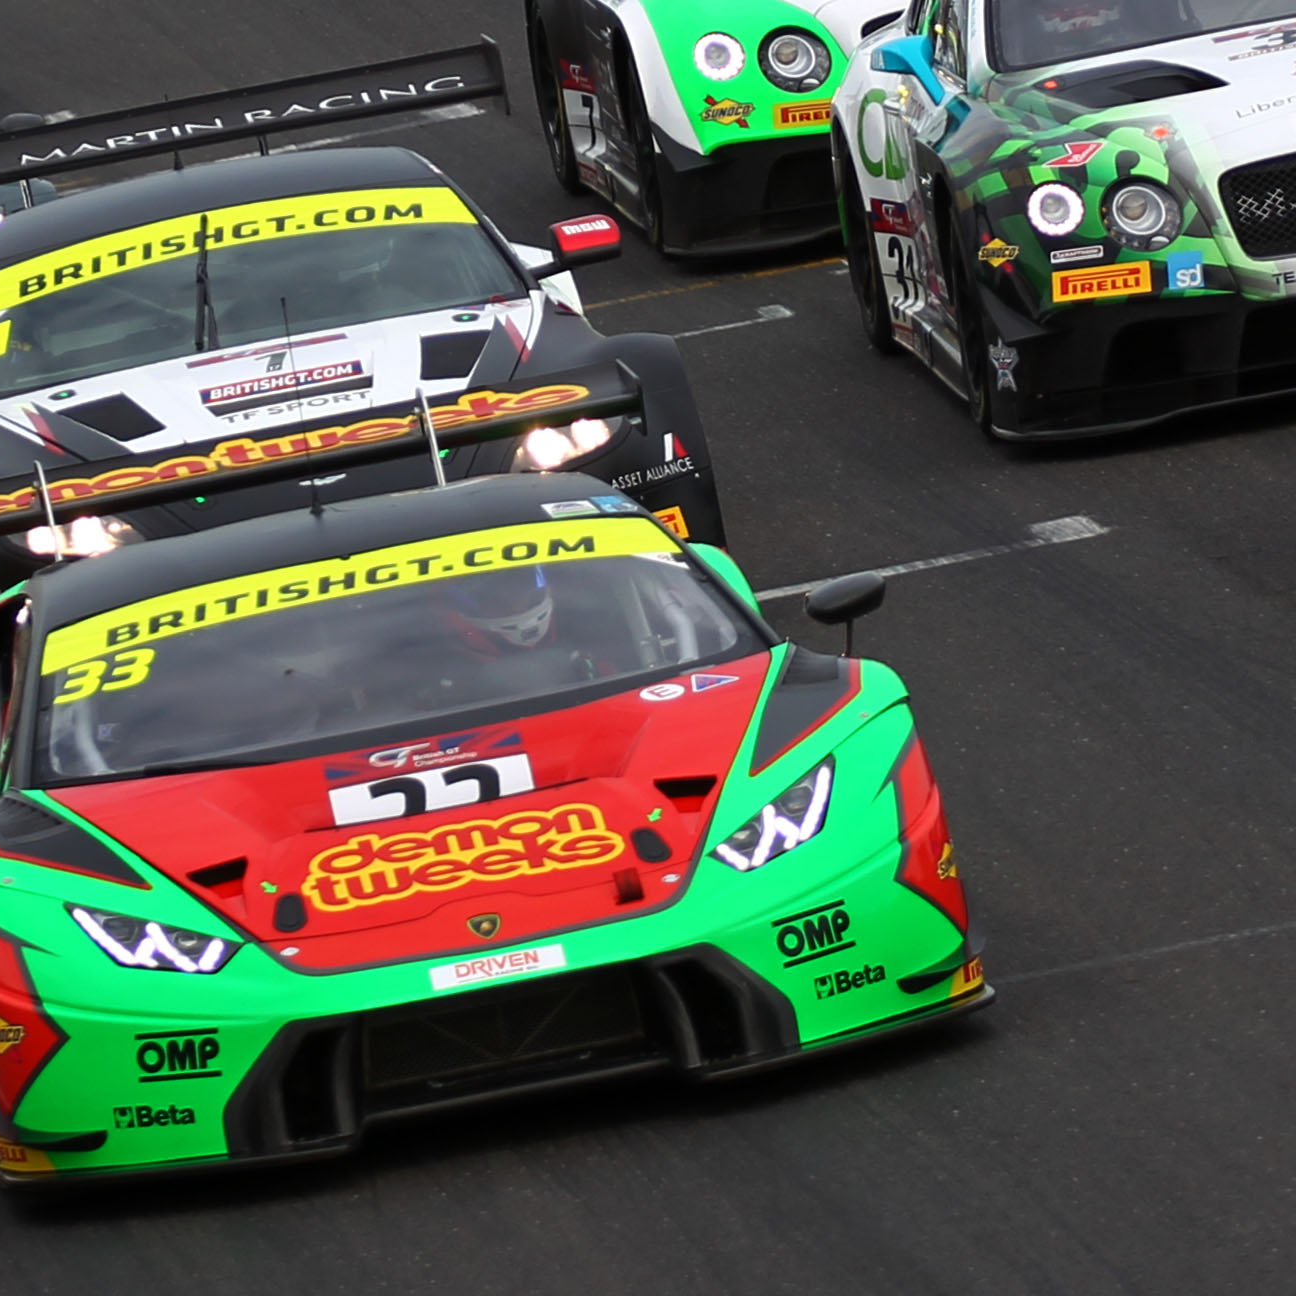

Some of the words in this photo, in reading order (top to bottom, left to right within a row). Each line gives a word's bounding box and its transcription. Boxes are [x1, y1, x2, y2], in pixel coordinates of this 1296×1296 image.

[20, 116, 224, 167] MARTIN
[242, 75, 466, 123] RACING
[701, 103, 754, 120] SUNOCO
[780, 99, 832, 126] PIRE
[17, 200, 425, 299] BRITISHGT.COM
[978, 246, 1020, 261] SUNOCO
[1059, 267, 1142, 296] PIRELLI
[1175, 263, 1204, 287] sd
[209, 363, 354, 400] BRITISHGT.COM
[221, 410, 263, 425] TF
[265, 389, 373, 416] SPORT
[610, 470, 642, 490] ASSET
[645, 457, 695, 484] ALLIANCE
[103, 533, 598, 649] BRITISHGT.COM
[54, 647, 156, 705] 33
[316, 806, 601, 876] demon
[307, 832, 622, 906] tweeks
[776, 908, 851, 958] OMP
[454, 950, 540, 978] DRIVEN
[833, 962, 886, 996] Beta
[136, 1037, 220, 1075] OMP
[135, 1104, 196, 1129] Beta
